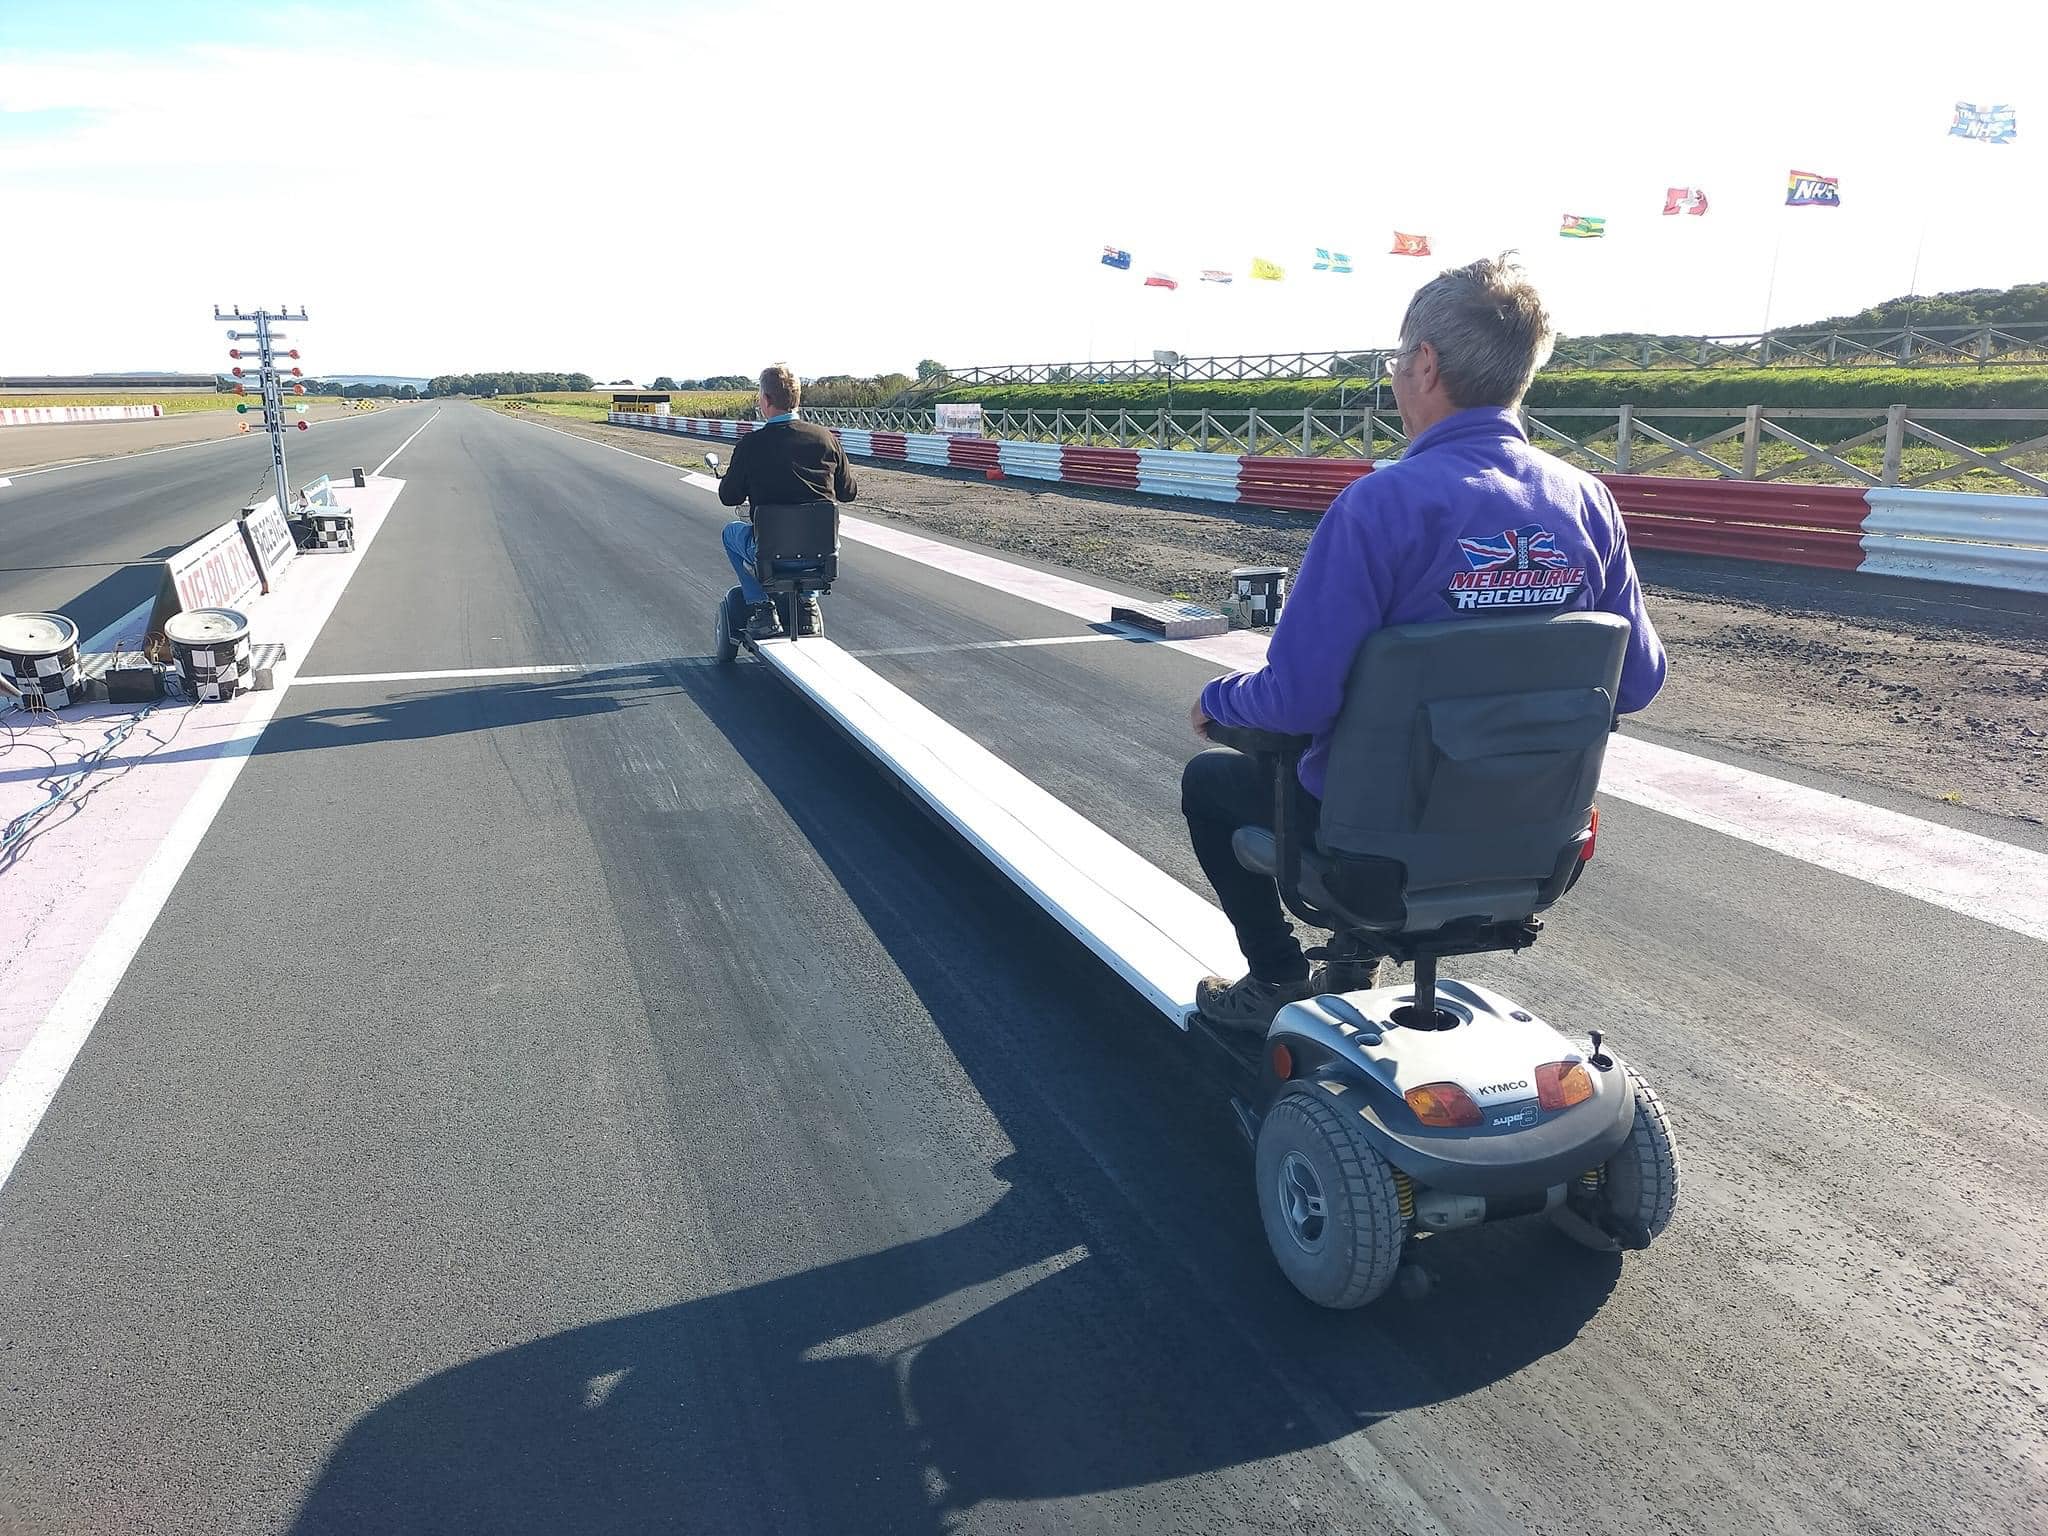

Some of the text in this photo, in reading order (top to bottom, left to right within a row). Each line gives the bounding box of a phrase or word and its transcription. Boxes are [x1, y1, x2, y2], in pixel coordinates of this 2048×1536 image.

[1793, 180, 1838, 200] NHS
[1448, 567, 1585, 590] MELBOURNE
[1450, 586, 1578, 608] Raceway
[1478, 1080, 1528, 1096] KYMCO
